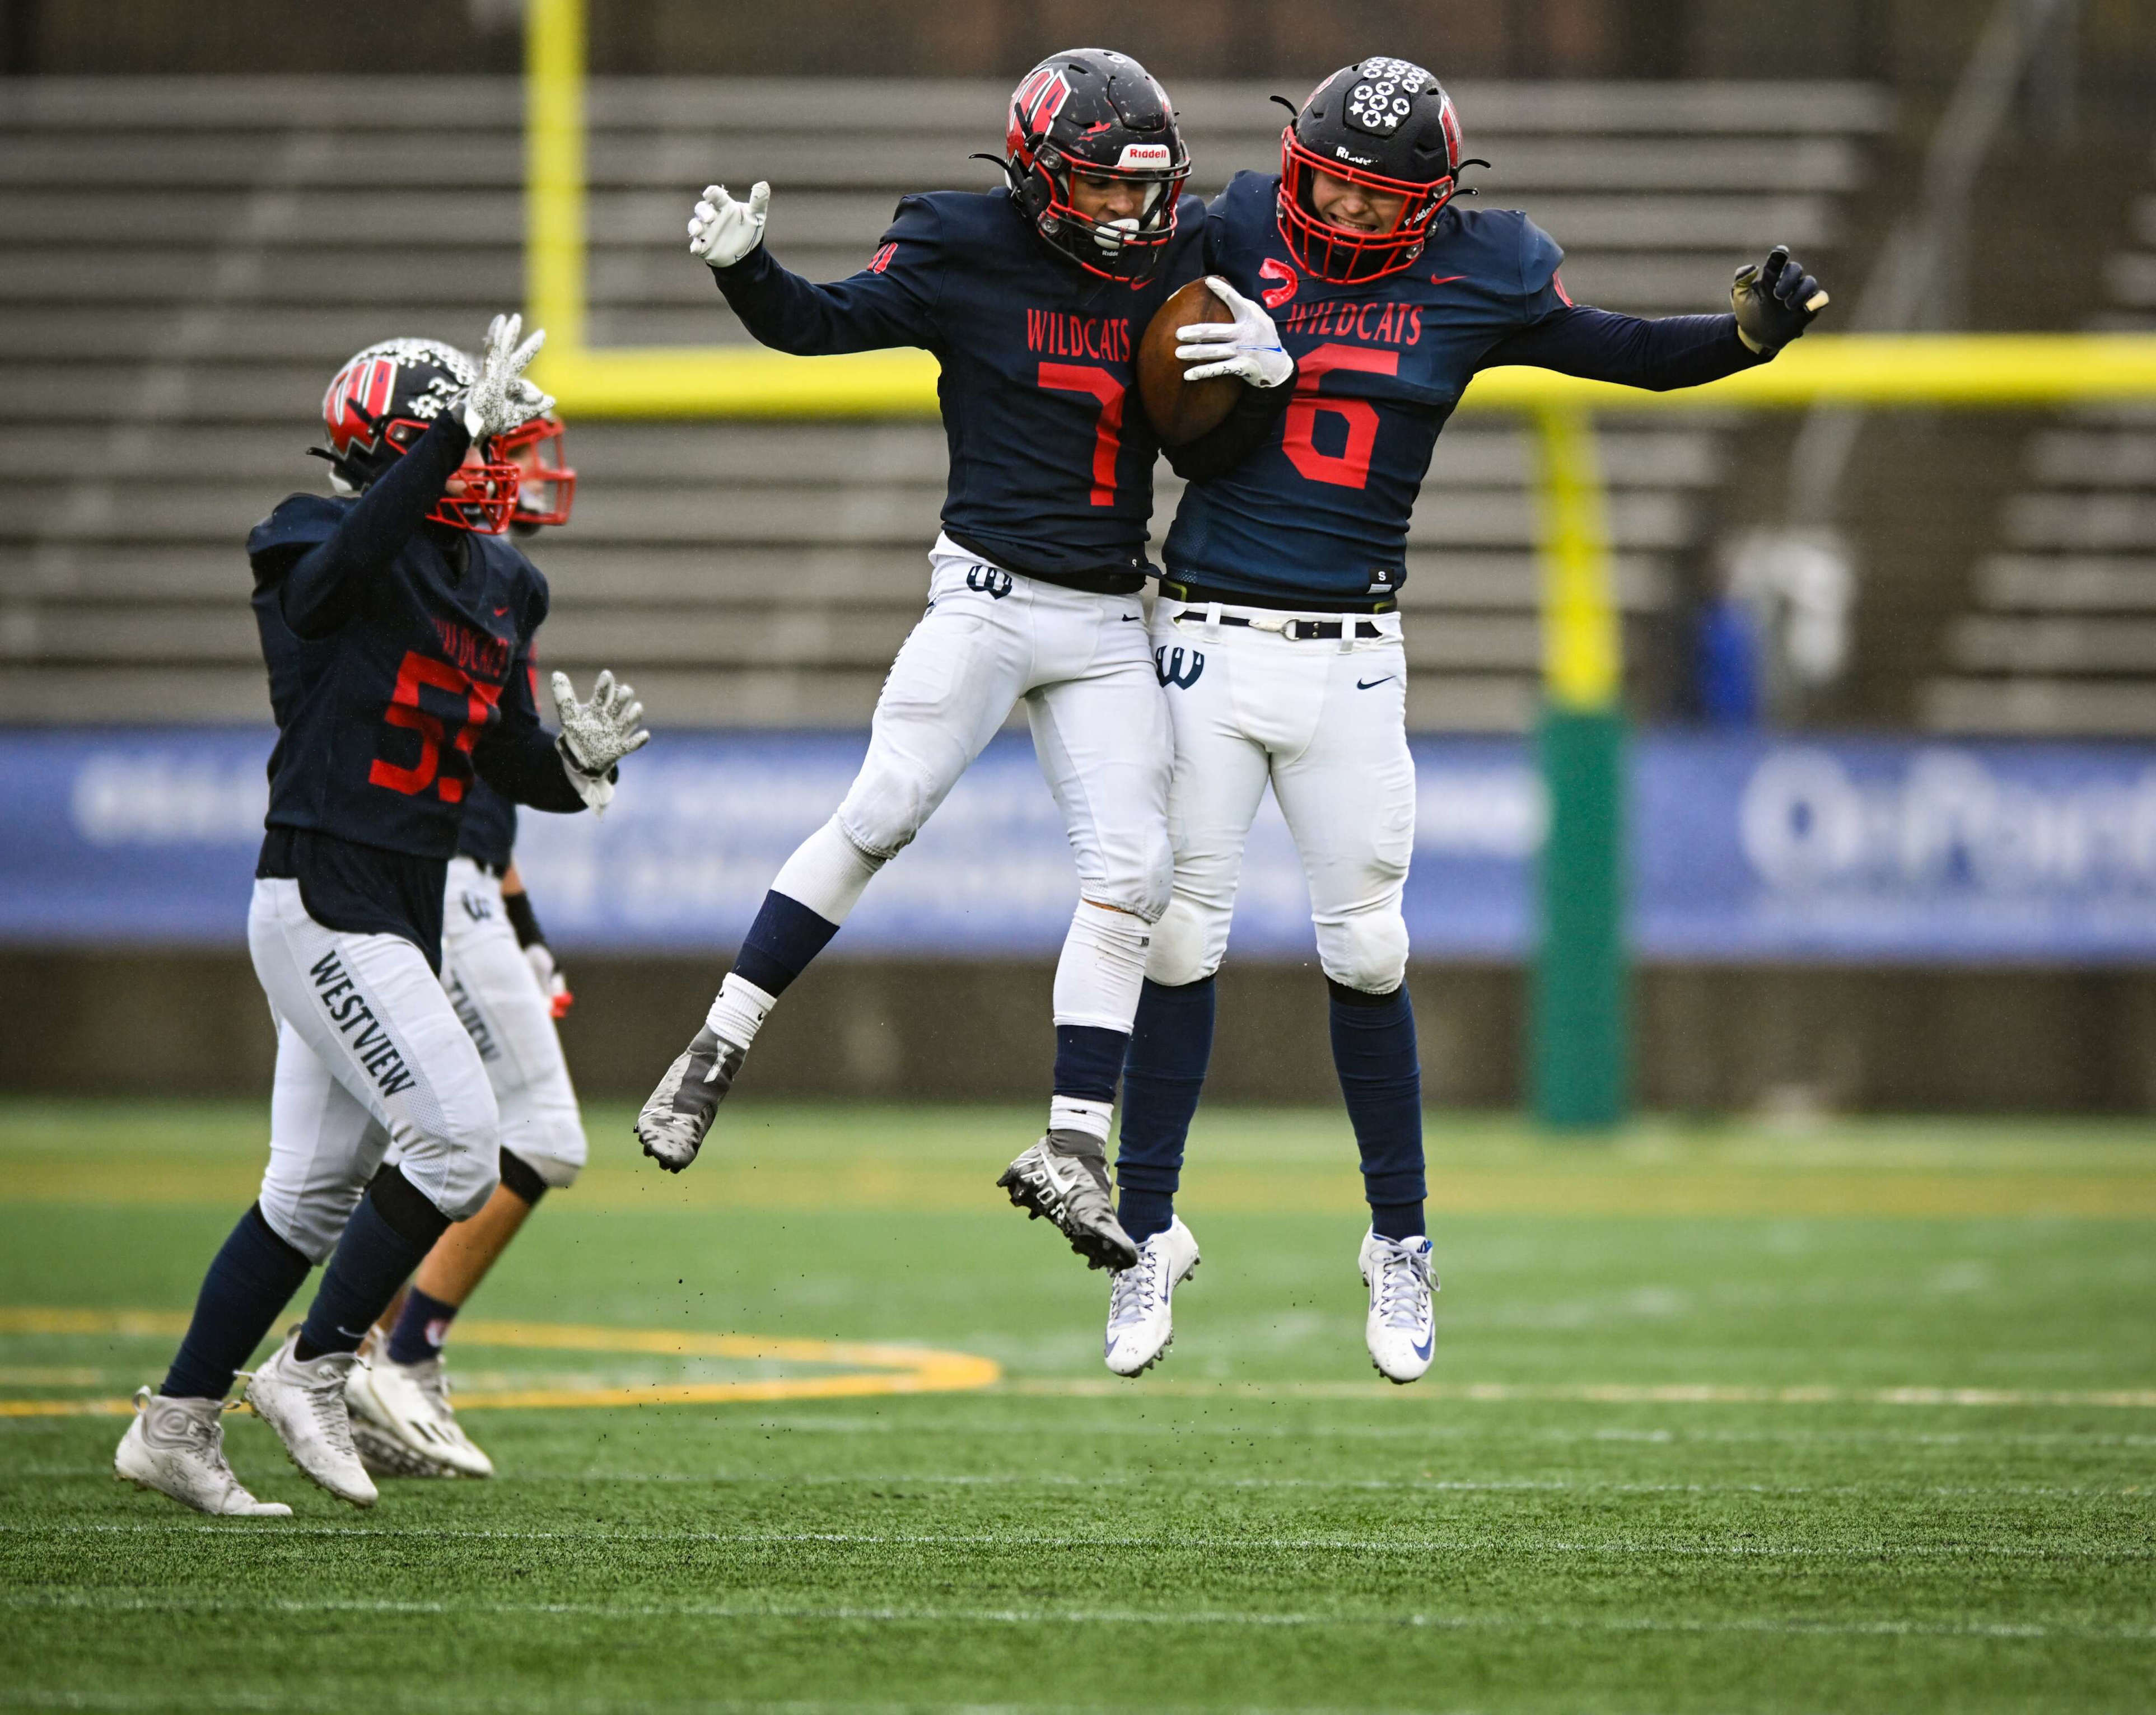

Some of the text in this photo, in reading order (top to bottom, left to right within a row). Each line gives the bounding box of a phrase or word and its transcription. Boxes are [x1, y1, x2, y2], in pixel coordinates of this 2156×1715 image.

[1129, 148, 1167, 159] Riddell
[1404, 202, 1436, 226] Rddell
[1027, 308, 1131, 362] WILDCATS
[1286, 302, 1424, 345] WILDCATS
[1038, 362, 1126, 507] 7
[1281, 342, 1399, 490] 6
[966, 565, 1012, 600] W
[1378, 571, 1387, 582] S
[1155, 645, 1205, 690] W
[310, 950, 416, 1097] WESTVIEW
